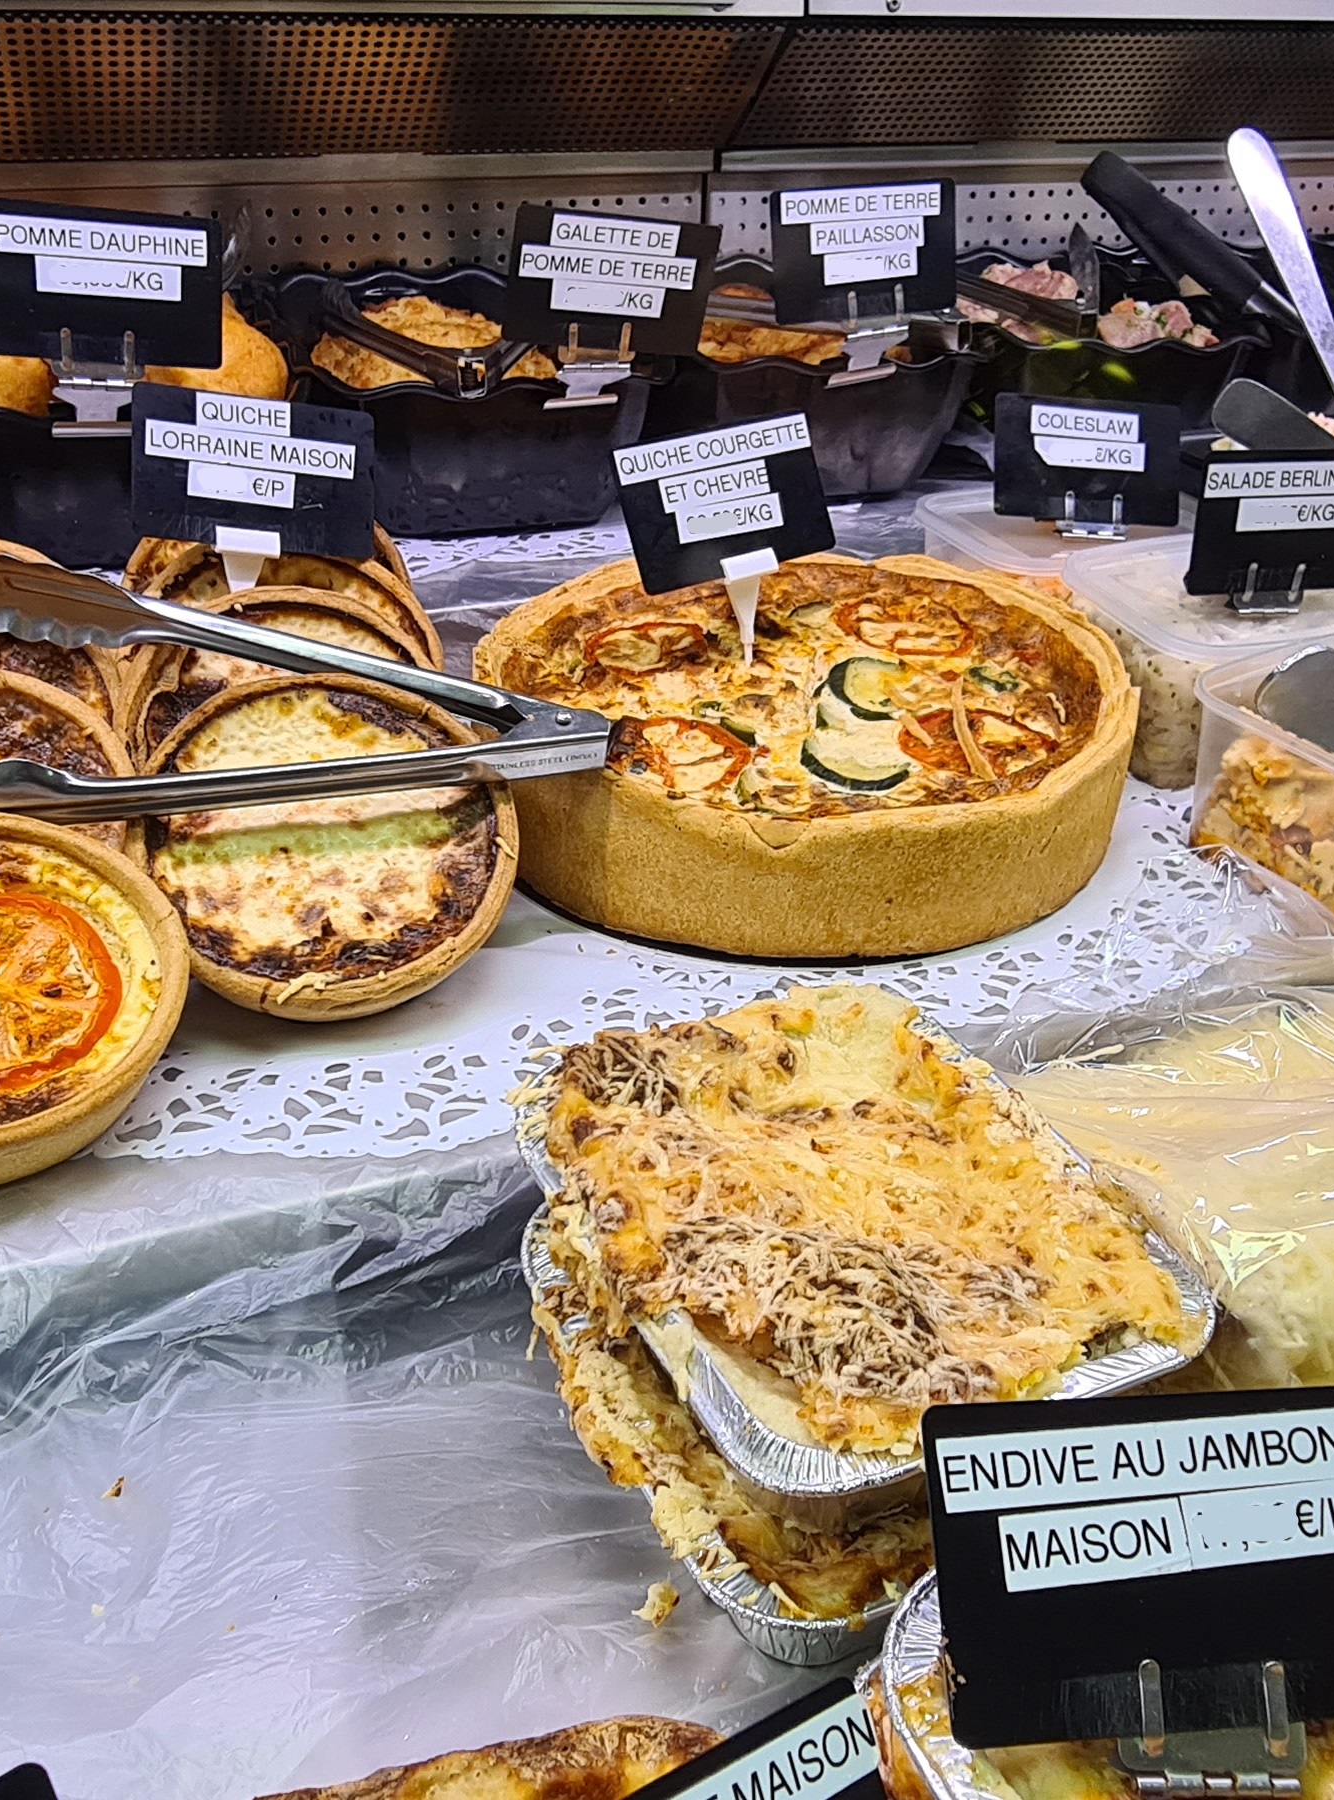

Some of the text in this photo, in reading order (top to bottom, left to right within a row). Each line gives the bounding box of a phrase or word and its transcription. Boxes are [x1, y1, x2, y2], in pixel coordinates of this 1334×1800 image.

[785, 191, 939, 217] POMME DE TERRE
[89, 231, 205, 258] DAUPHINE
[556, 223, 675, 250] GALETTE DE
[816, 224, 920, 247] PAILLASSON
[521, 252, 693, 283] POMME DE TERRE
[201, 401, 287, 429] QUICHE
[1038, 412, 1133, 435] COLESLAW
[150, 428, 353, 471] LORRAINE MAISON
[619, 421, 807, 475] QUICHE COURGETTE
[664, 466, 769, 504] ET CHEVRE
[1207, 471, 1276, 491] SALADE
[538, 756, 563, 767] STEEL
[942, 1444, 1099, 1493] ENDIVE
[1111, 1437, 1166, 1480] AU
[1005, 1516, 1173, 1572] MAISON
[731, 1708, 876, 1800] MAISON
